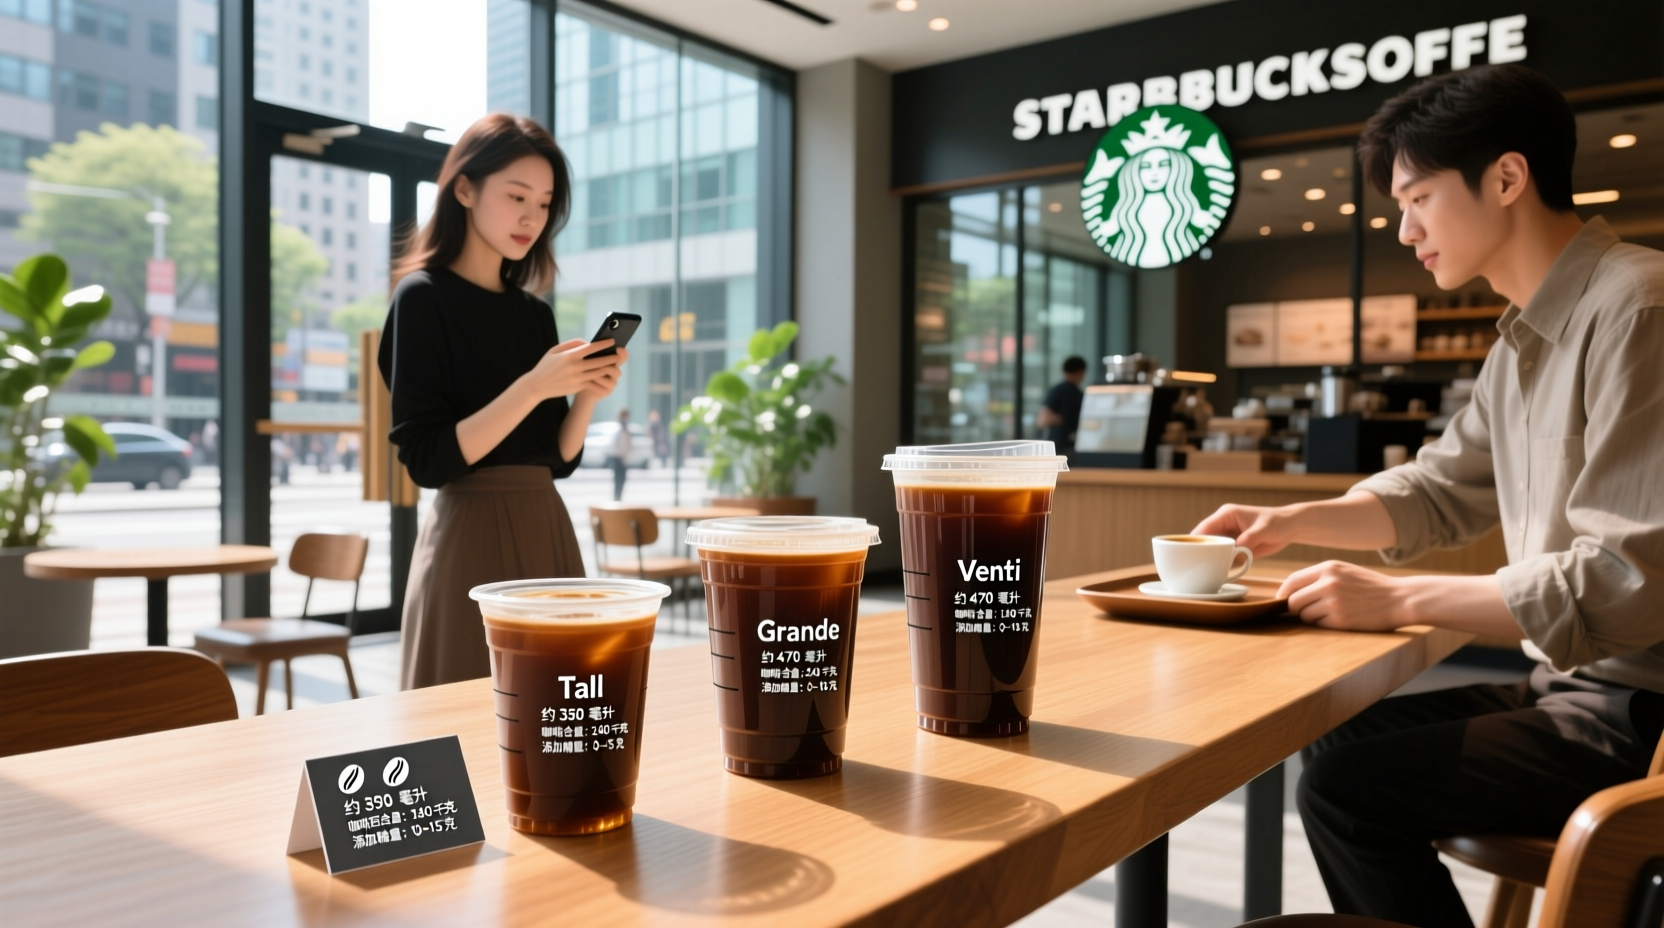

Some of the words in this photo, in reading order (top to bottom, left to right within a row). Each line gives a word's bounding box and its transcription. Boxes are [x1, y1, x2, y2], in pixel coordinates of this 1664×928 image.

[957, 558, 1021, 582] Venti
[954, 591, 966, 605] 约
[969, 591, 993, 604] 470
[757, 618, 840, 642] Grande
[761, 650, 774, 663] 约
[776, 650, 800, 663] 470
[557, 674, 603, 699] Tall
[541, 707, 556, 722] 约
[559, 708, 584, 721] 350
[344, 798, 360, 816] 约
